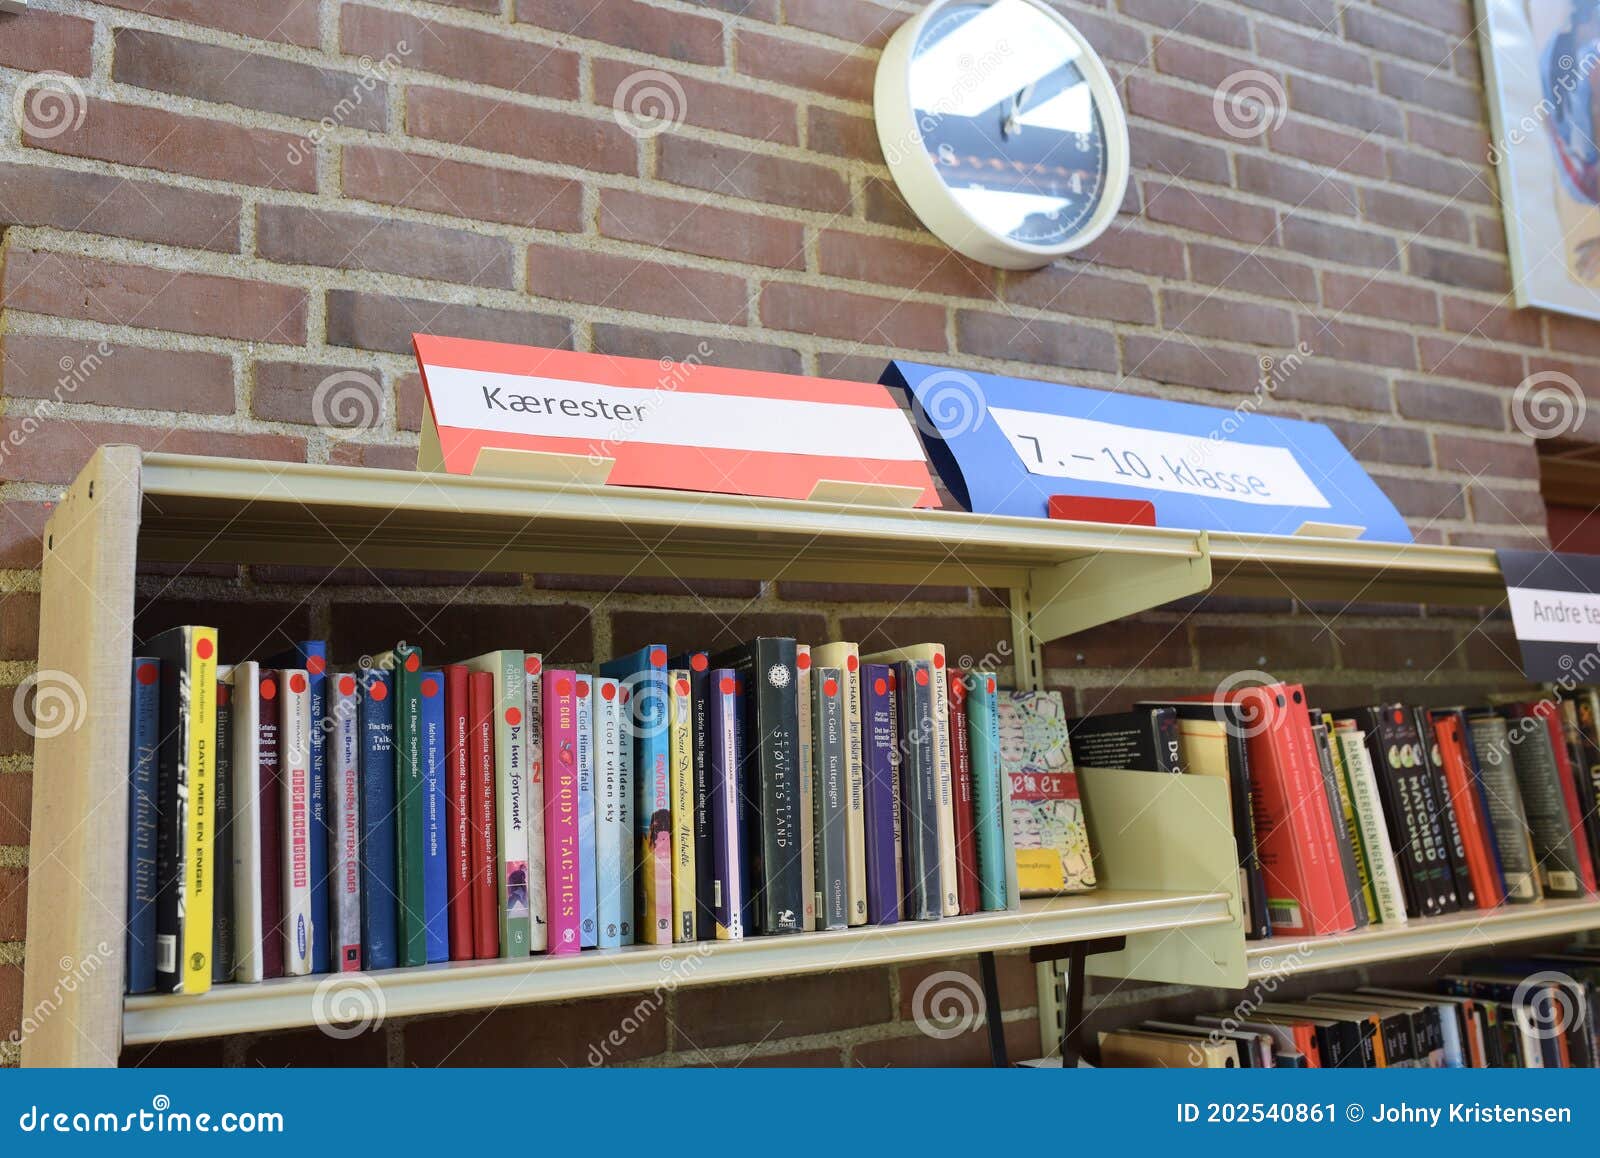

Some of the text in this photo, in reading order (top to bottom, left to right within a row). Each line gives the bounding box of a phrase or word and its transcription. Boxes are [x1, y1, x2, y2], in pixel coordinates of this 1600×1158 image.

[481, 385, 649, 423] Kærester
[1164, 454, 1267, 498] klasse
[1533, 600, 1582, 624] Andre
[849, 671, 857, 685] LIS
[311, 694, 322, 716] Aage
[410, 698, 418, 713] Kari
[531, 680, 539, 745] JULIE CLAUSEN
[560, 707, 571, 729] CLOD
[579, 710, 588, 731] Clod
[697, 712, 705, 731] Edvin
[827, 702, 838, 744] De Goldi
[218, 711, 229, 749] Blume
[312, 719, 322, 752] Brandt:
[344, 719, 353, 764] Ina Bruhn
[428, 722, 437, 745] Melvin
[606, 721, 614, 745] Clod
[697, 732, 705, 749] Dahl:
[851, 735, 860, 760] elsker
[137, 744, 155, 782] Den
[313, 755, 323, 772] Når
[410, 736, 419, 778] Spejlbilleder
[579, 734, 589, 792] Himmelfald
[429, 778, 437, 792] Den
[458, 779, 467, 792] Når
[510, 726, 522, 831] Da hun forsvandt
[606, 760, 615, 797] vilden
[619, 761, 628, 798] vilden
[654, 753, 667, 808] FAVNTAG
[773, 731, 787, 848] STØVETS LAND
[783, 732, 793, 847] METTE FINDERUP
[828, 755, 839, 809] Kattepigen
[852, 776, 862, 811] Thomas
[941, 774, 950, 806] Thomas
[216, 783, 227, 812] evigt
[314, 802, 323, 822] sker
[429, 794, 438, 821] sommer
[605, 803, 615, 824] sky
[136, 789, 155, 848] anden
[195, 739, 206, 897] DATE MED EN ENGEL
[345, 769, 358, 894] GENNEM NATTENS GADER
[458, 817, 467, 848] begynder
[1346, 740, 1387, 878] DANSKLÆRERFORENINGENS
[1379, 880, 1396, 919] FORLAG
[1399, 777, 1422, 863] MATCHED
[1411, 776, 1435, 861] MATCHED
[484, 823, 493, 853] begynder
[559, 775, 573, 917] BODY TACTICS
[680, 824, 691, 867] Michelle
[135, 856, 154, 902] kind
[832, 879, 842, 918] Gyldendal
